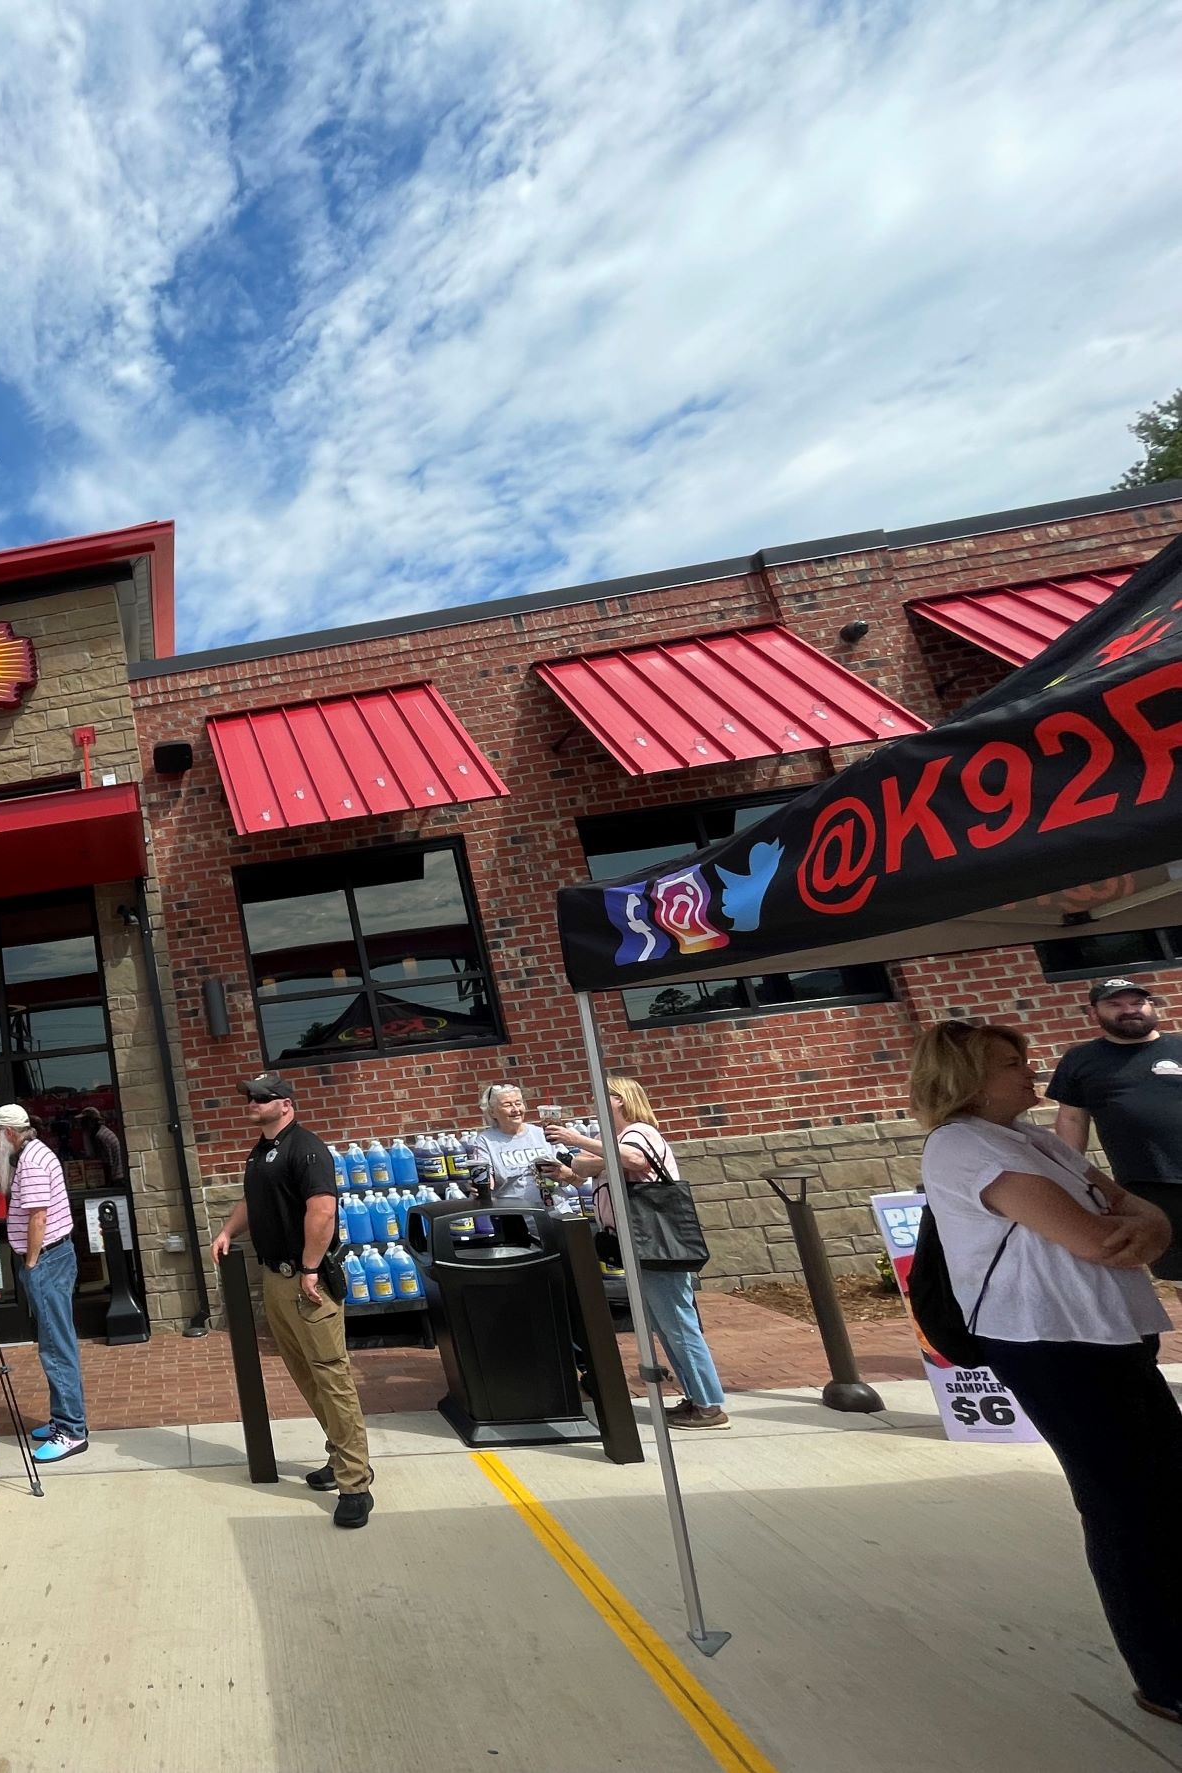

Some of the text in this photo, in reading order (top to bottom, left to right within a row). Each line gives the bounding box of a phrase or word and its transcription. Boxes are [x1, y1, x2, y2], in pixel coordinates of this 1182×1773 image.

[955, 1371, 990, 1382] APPZ
[945, 1382, 1007, 1394] SAMPLER
[951, 1396, 1015, 1426] $6
